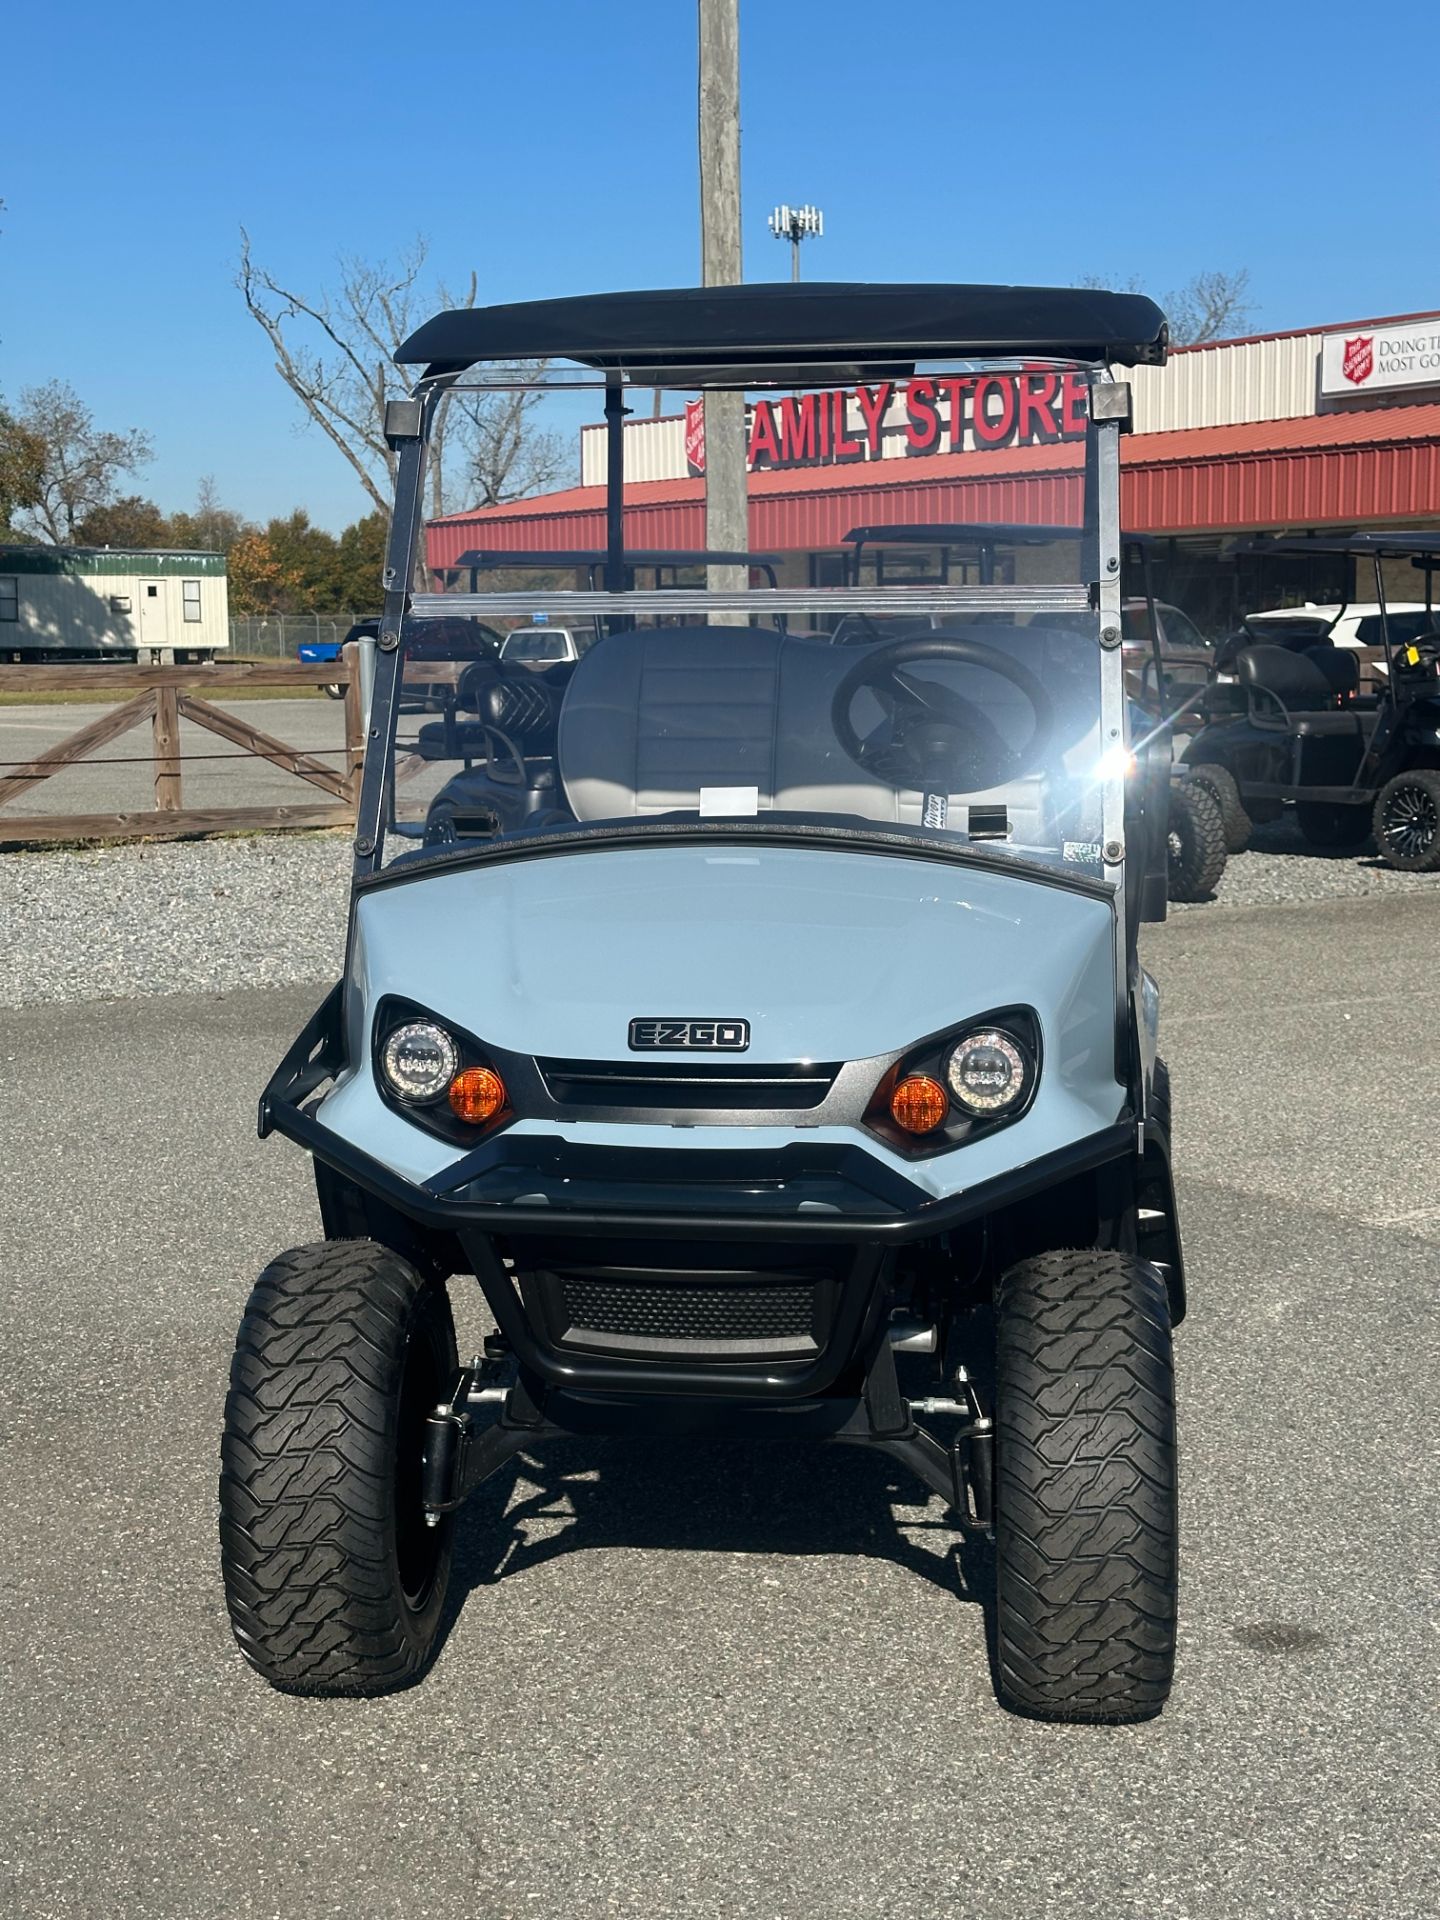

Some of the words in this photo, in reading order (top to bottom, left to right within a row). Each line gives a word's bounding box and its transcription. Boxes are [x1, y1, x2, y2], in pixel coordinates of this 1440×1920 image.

[1379, 337, 1426, 356] DOING
[1378, 355, 1416, 374] MOST
[1419, 353, 1440, 369] GO
[747, 383, 893, 465] AMILY
[905, 363, 1088, 449] STORE
[632, 1021, 746, 1047] EZGO
